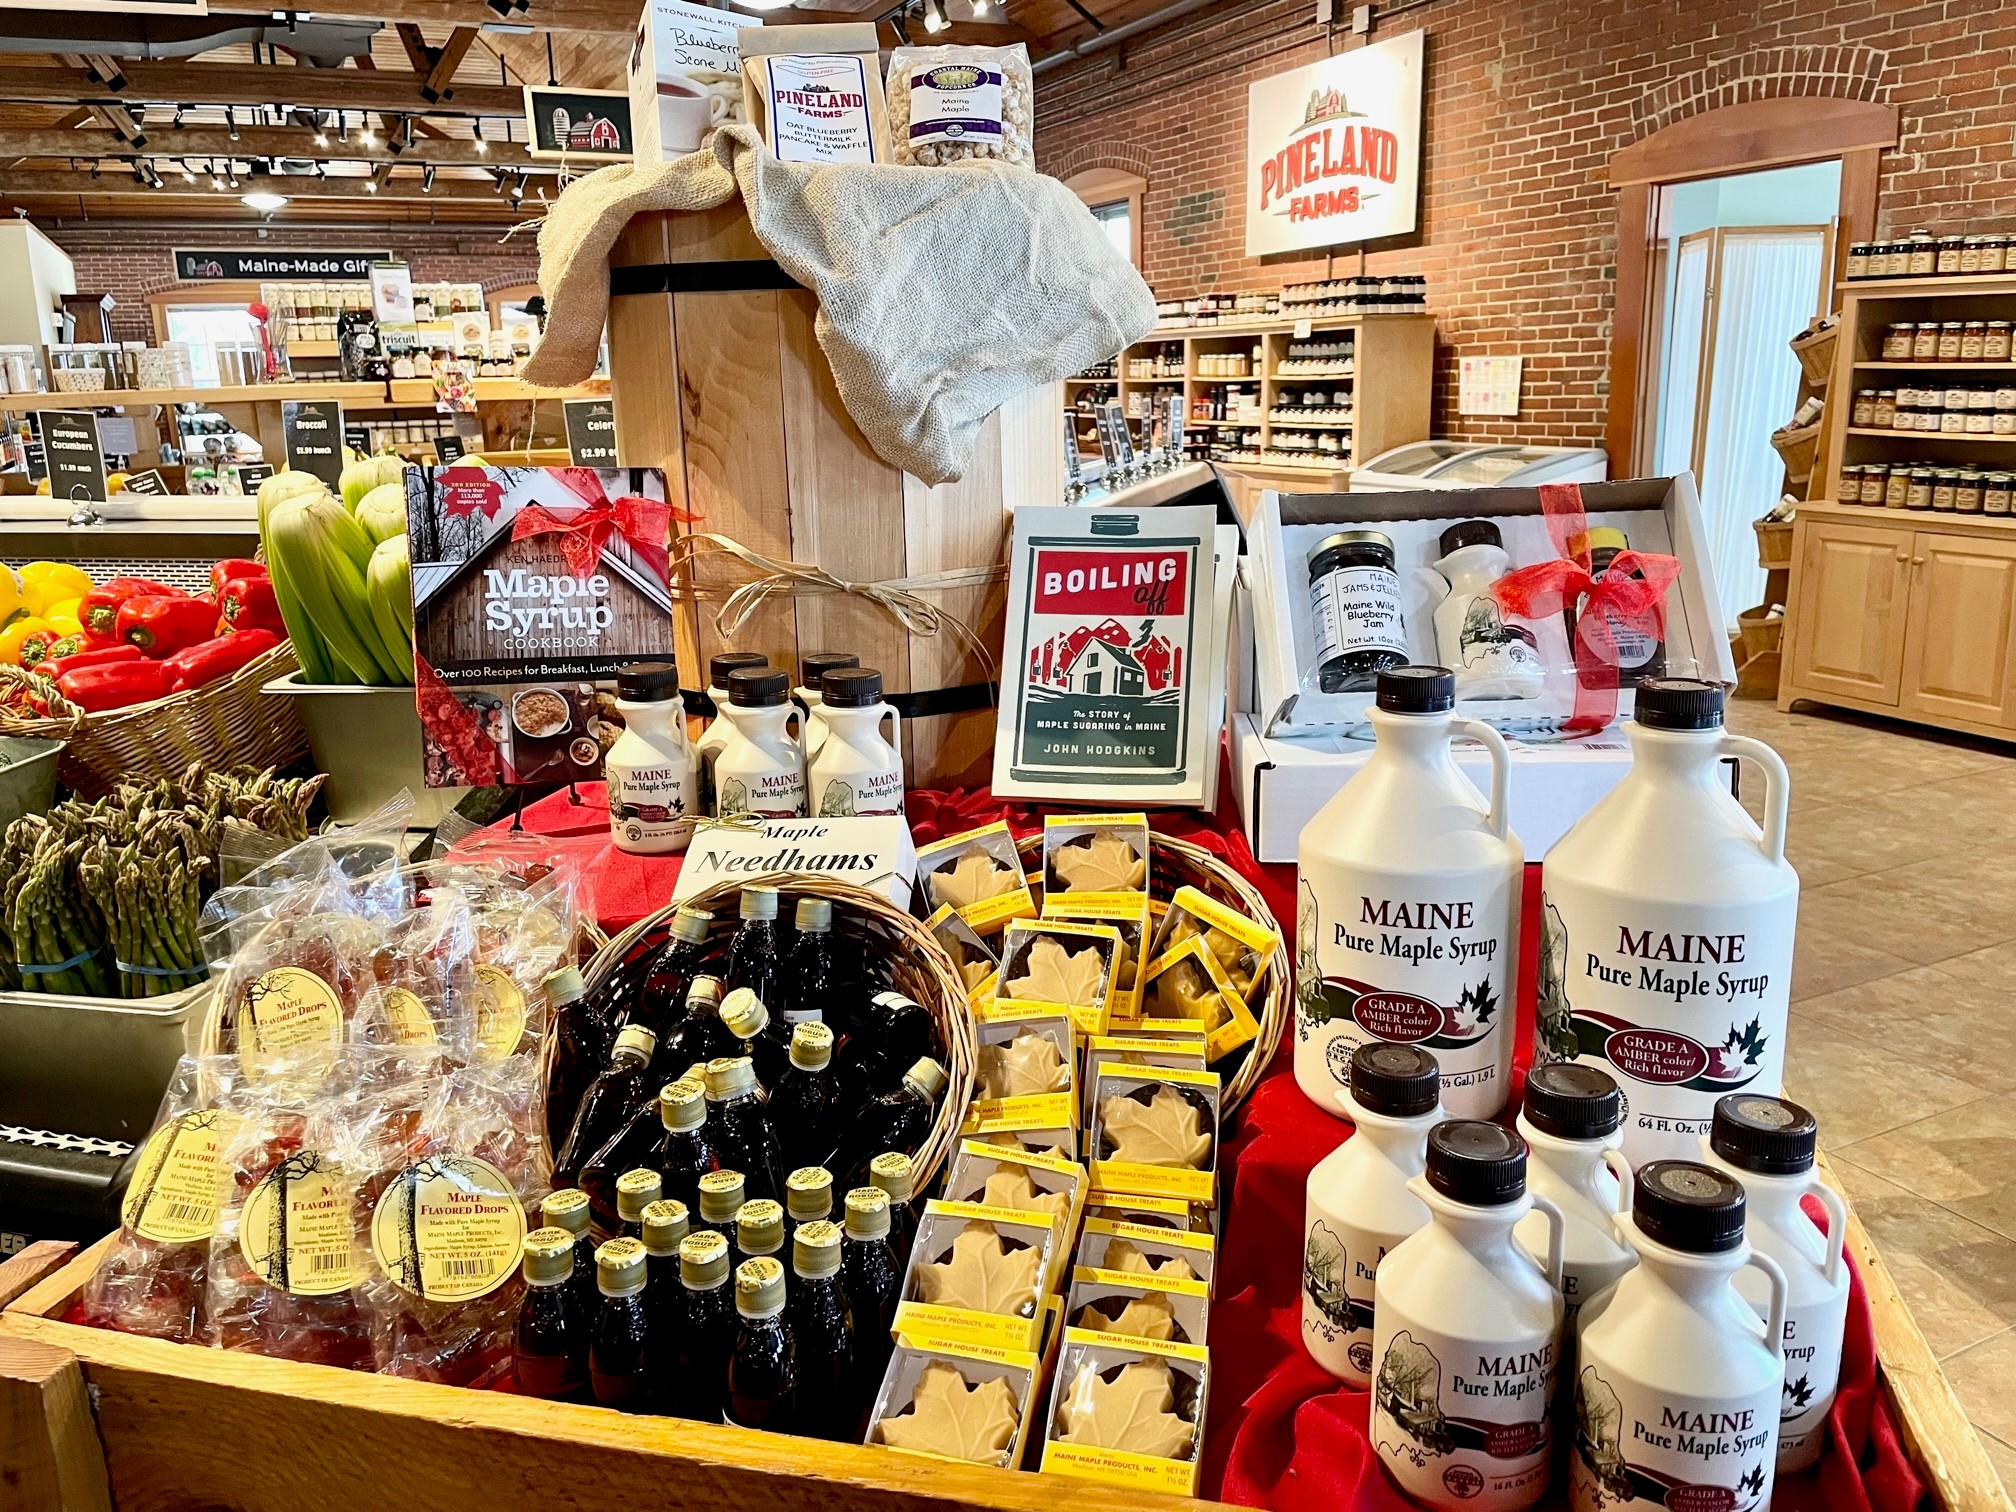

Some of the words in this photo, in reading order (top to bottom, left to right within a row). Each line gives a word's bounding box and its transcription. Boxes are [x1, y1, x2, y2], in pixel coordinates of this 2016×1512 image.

[657, 7, 716, 23] STONEWALL
[674, 48, 717, 70] Scone
[929, 66, 960, 76] COASTAL
[960, 66, 982, 74] MAINE
[775, 90, 863, 108] PINELAND
[797, 107, 843, 118] FARMS
[941, 105, 970, 113] Maple
[786, 121, 804, 130] OAT
[806, 127, 858, 135] BLUEBERRY
[779, 134, 823, 147] PANCAKE
[831, 141, 868, 150] WAFFLE
[794, 130, 851, 142] BUTTERMILK
[1260, 124, 1399, 211] PINELAND
[1288, 186, 1360, 224] FARMS
[238, 259, 339, 273] Maine-Made
[382, 333, 416, 346] triscuit
[296, 420, 328, 430] Broccoli
[52, 429, 89, 439] European
[51, 440, 94, 452] Cucumbers
[580, 448, 606, 459] $2.99
[77, 465, 92, 473] each
[506, 555, 529, 564] KEN
[1042, 557, 1177, 596] BOILING
[1370, 573, 1397, 587] MAINE
[484, 568, 610, 604] Maple
[1133, 578, 1170, 616] off
[1343, 601, 1373, 612] Maine
[1375, 600, 1395, 612] Wild
[486, 601, 614, 638] Syrup
[1347, 611, 1394, 622] Blueberry
[1363, 620, 1384, 628] Jam
[504, 636, 599, 650] COOKBOOK
[1347, 636, 1361, 644] Net
[433, 668, 459, 680] Over
[461, 668, 482, 678] 100
[483, 665, 523, 680] Recipes
[524, 664, 540, 676] for
[540, 662, 590, 675] Breakfast,
[590, 661, 621, 673] Lunch
[1072, 710, 1086, 718] The
[1088, 710, 1120, 719] STORY
[1123, 710, 1132, 721] of
[1036, 720, 1069, 730] MAPLE
[1072, 721, 1121, 731] SUGARING
[1125, 722, 1133, 731] in
[1135, 722, 1167, 732] MAINE
[1043, 743, 1080, 755] JOHN
[1086, 744, 1156, 756] HODGKINS
[631, 769, 671, 780] MAINE
[761, 773, 799, 788] MAINE
[868, 772, 899, 788] MAINE
[623, 781, 637, 790] Pure
[639, 782, 660, 793] Maple
[661, 780, 681, 792] Syrup
[752, 789, 768, 799] Pure
[769, 786, 789, 799] Maple
[790, 784, 805, 795] Syrup
[858, 790, 874, 799] Pure
[875, 787, 895, 799] Maple
[761, 825, 829, 839] Maple
[695, 848, 878, 874] Needhams
[1360, 896, 1475, 930] MAINE
[1052, 923, 1071, 931] HOUSE
[1072, 924, 1094, 932] TREATS
[1334, 923, 1374, 953] Pure
[1380, 934, 1443, 966] Maple
[1448, 936, 1497, 966] Syrup
[1616, 926, 1745, 964] MAINE
[1586, 953, 1632, 987] Pure
[1638, 966, 1710, 1002] Maple
[1716, 972, 1768, 1003] Syrup
[1368, 998, 1415, 1015] GRADE
[1416, 1004, 1426, 1015] A
[1361, 1009, 1401, 1024] AMBER
[1403, 1015, 1433, 1027] color/
[796, 1028, 829, 1039] ROBUST
[804, 1022, 825, 1031] DARK
[1369, 1021, 1392, 1034] Rich
[1394, 1022, 1424, 1036] flavor
[1623, 1035, 1675, 1053] GRADE
[1677, 1043, 1689, 1054] A
[1614, 1047, 1660, 1063] AMBER
[1663, 1055, 1696, 1067] color/
[1625, 1059, 1649, 1072] Rich
[1652, 1063, 1685, 1077] flavor
[1454, 1074, 1475, 1088] Gal.)
[1477, 1072, 1488, 1084] 1.9
[1489, 1071, 1496, 1083] L
[1638, 1117, 1652, 1129] 64
[1656, 1120, 1672, 1132] Fl.
[1674, 1122, 1695, 1133] Oz.
[447, 1193, 482, 1203] MAPLE
[420, 1205, 472, 1215] FLAVORED
[474, 1205, 509, 1214] DROPS
[1111, 1222, 1135, 1231] SUGAR
[1136, 1227, 1159, 1236] HOUSE
[1161, 1231, 1184, 1240] TREATS
[526, 1236, 566, 1244] ROBUST
[429, 1252, 445, 1260] NET
[485, 1249, 507, 1257] (141g)
[1103, 1272, 1127, 1281] SUGAR
[1128, 1275, 1153, 1285] HOUSE
[1155, 1278, 1180, 1288] TREATS
[928, 1339, 953, 1348] SUGAR
[954, 1343, 979, 1353] HOUSE
[981, 1348, 1006, 1357] TREATS
[1097, 1334, 1121, 1344] SUGAR
[1122, 1337, 1148, 1347] HOUSE
[1151, 1340, 1177, 1351] TREATS
[1476, 1343, 1553, 1377] MAINE
[1452, 1375, 1488, 1397] Pure
[1493, 1378, 1536, 1401] Maple
[1661, 1406, 1754, 1434] MAINE
[1633, 1420, 1672, 1449] Pure
[1677, 1434, 1729, 1461] Maple
[1734, 1430, 1768, 1457] Syrup
[1054, 1452, 1077, 1461] MAINE
[1078, 1456, 1101, 1465] MAPLE
[1143, 1466, 1158, 1474] INC.
[1165, 1466, 1178, 1474] NET
